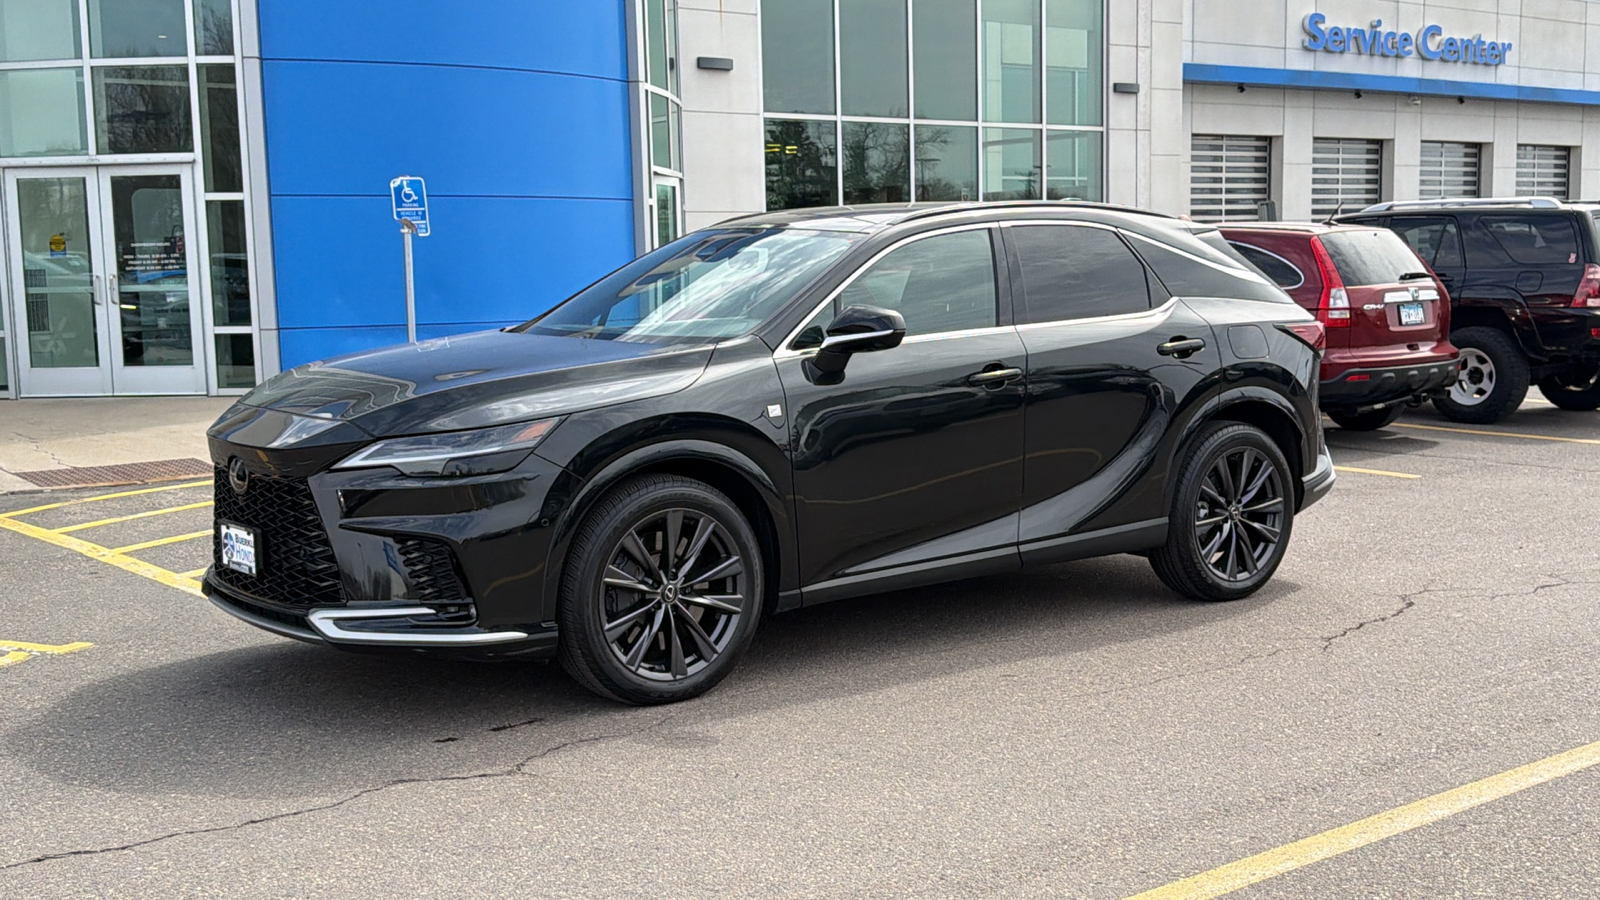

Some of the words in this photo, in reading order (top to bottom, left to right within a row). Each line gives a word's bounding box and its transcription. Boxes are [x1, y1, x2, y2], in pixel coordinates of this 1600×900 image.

[1303, 13, 1413, 57] Service
[1417, 24, 1512, 65] Center
[234, 533, 253, 548] BUERKL
[235, 545, 255, 563] HOND
